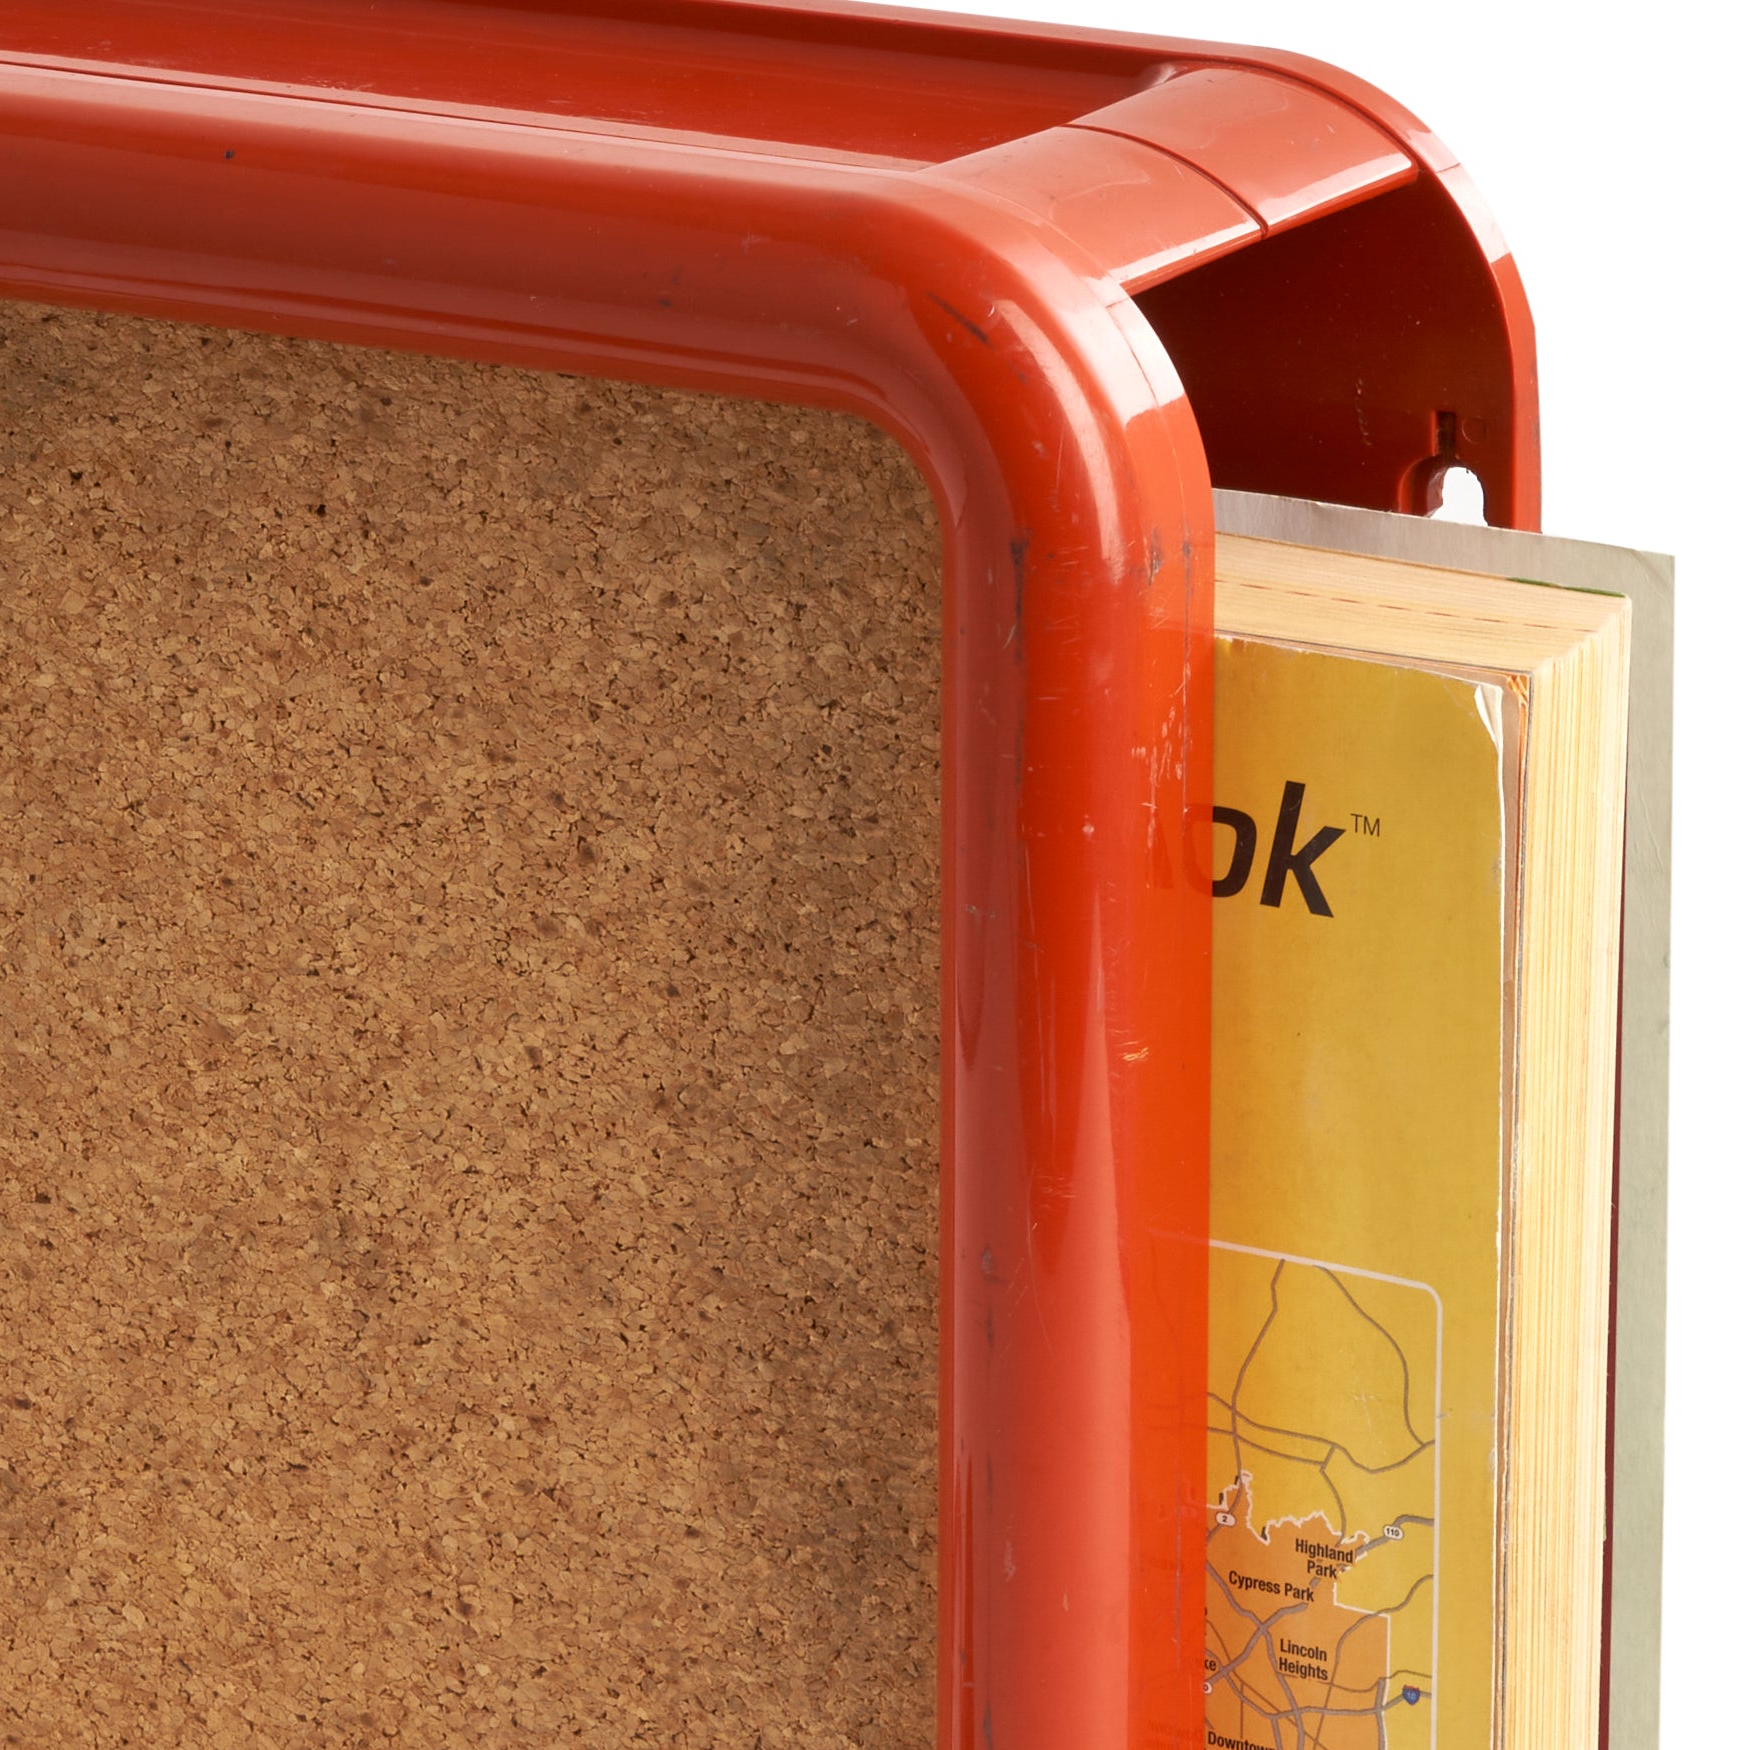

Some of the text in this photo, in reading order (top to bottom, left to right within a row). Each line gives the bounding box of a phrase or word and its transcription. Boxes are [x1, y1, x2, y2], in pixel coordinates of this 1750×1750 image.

[1211, 780, 1381, 918] ok TM
[1386, 1527, 1400, 1537] 110
[1295, 1538, 1353, 1563] Highland
[1307, 1560, 1337, 1579] Park
[1229, 1570, 1314, 1602] Cypress Park
[1280, 1638, 1327, 1662] Lincoln
[1279, 1657, 1329, 1681] Heights
